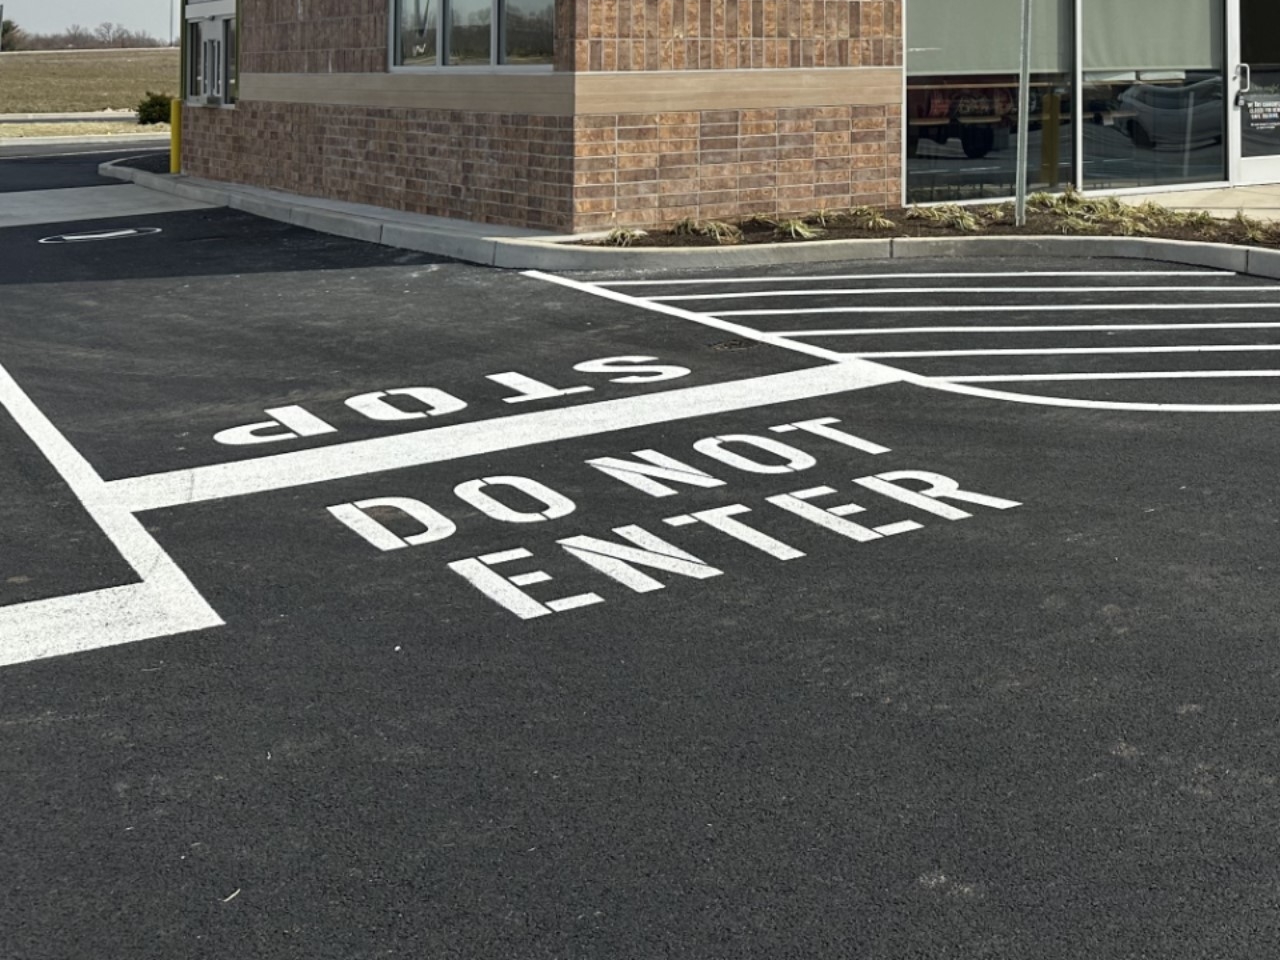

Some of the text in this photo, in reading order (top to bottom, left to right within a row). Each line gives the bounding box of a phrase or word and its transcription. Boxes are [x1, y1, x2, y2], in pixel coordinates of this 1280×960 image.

[213, 355, 691, 445] STOP
[325, 417, 892, 552] DO NOT
[447, 469, 1024, 620] ENTER
